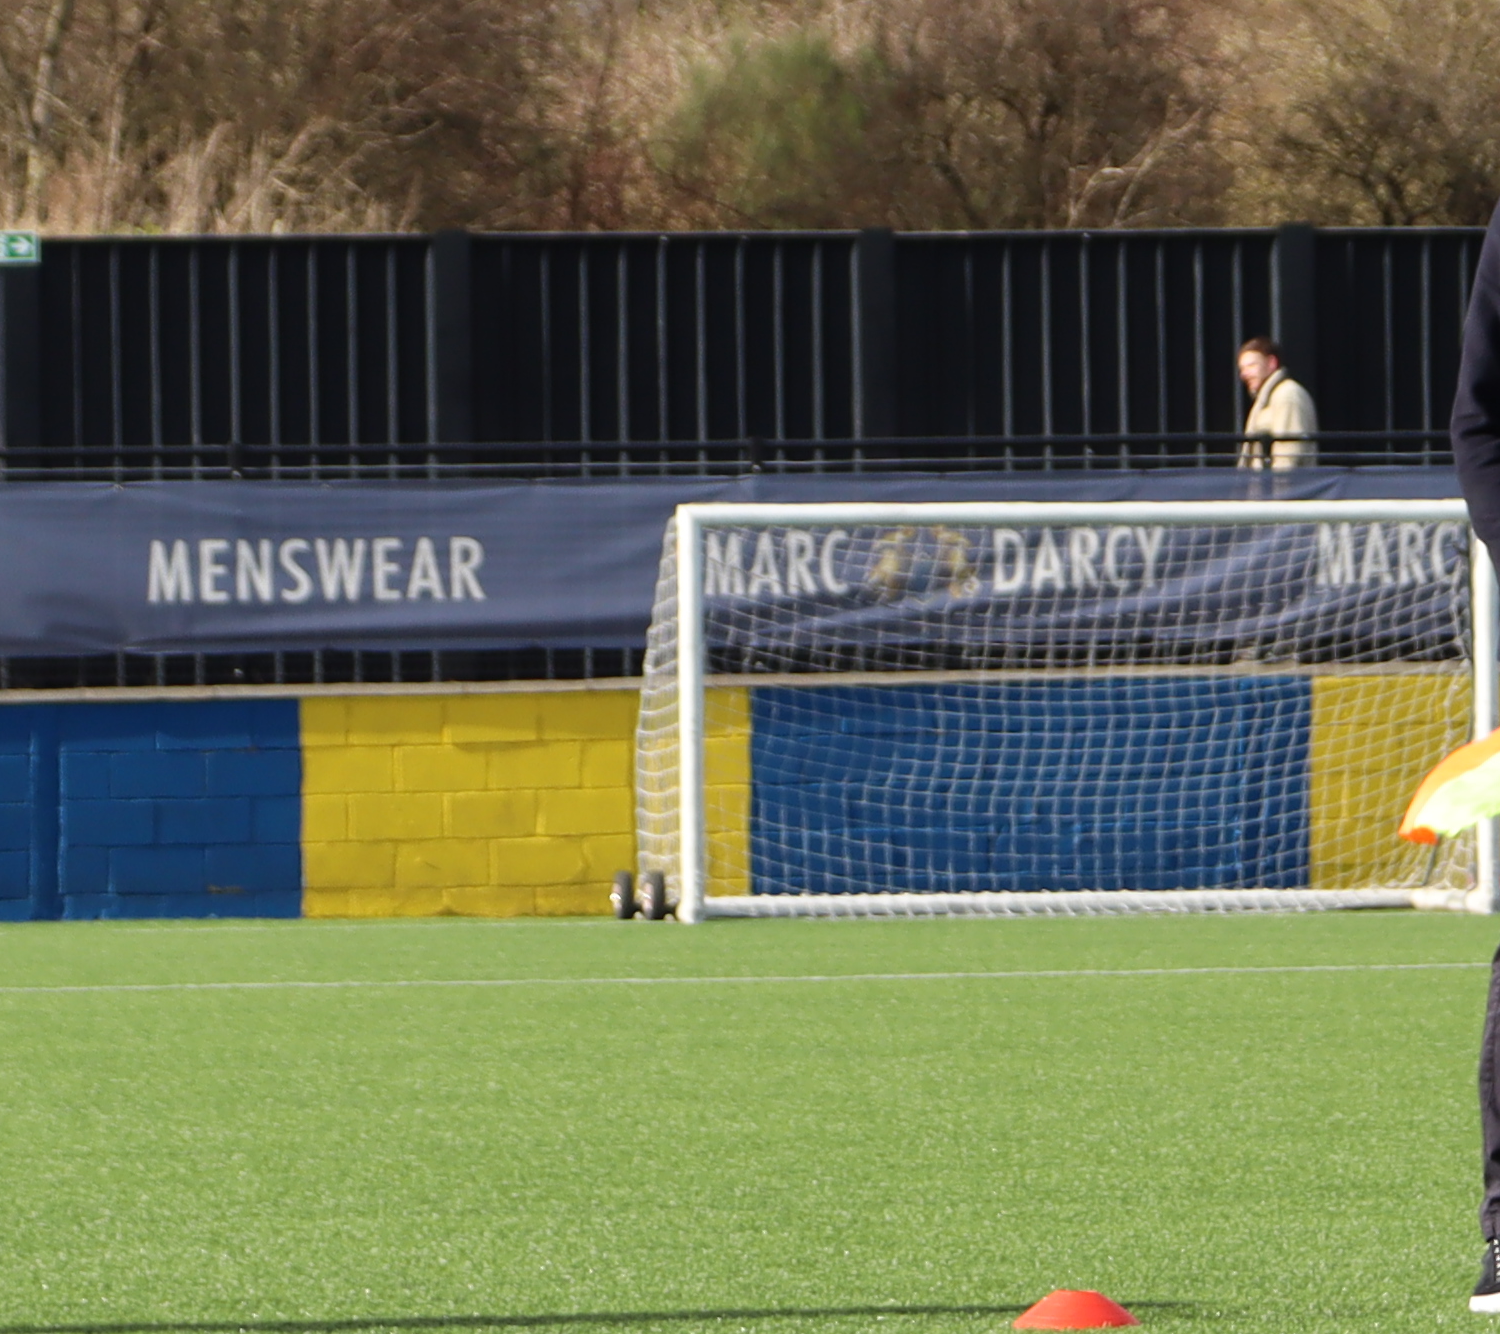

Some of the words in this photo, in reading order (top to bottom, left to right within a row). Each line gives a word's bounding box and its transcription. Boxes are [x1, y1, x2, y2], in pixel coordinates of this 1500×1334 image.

[148, 537, 486, 604] MENSWEAR
[703, 529, 849, 595] MARC
[994, 526, 1164, 593] DARCY
